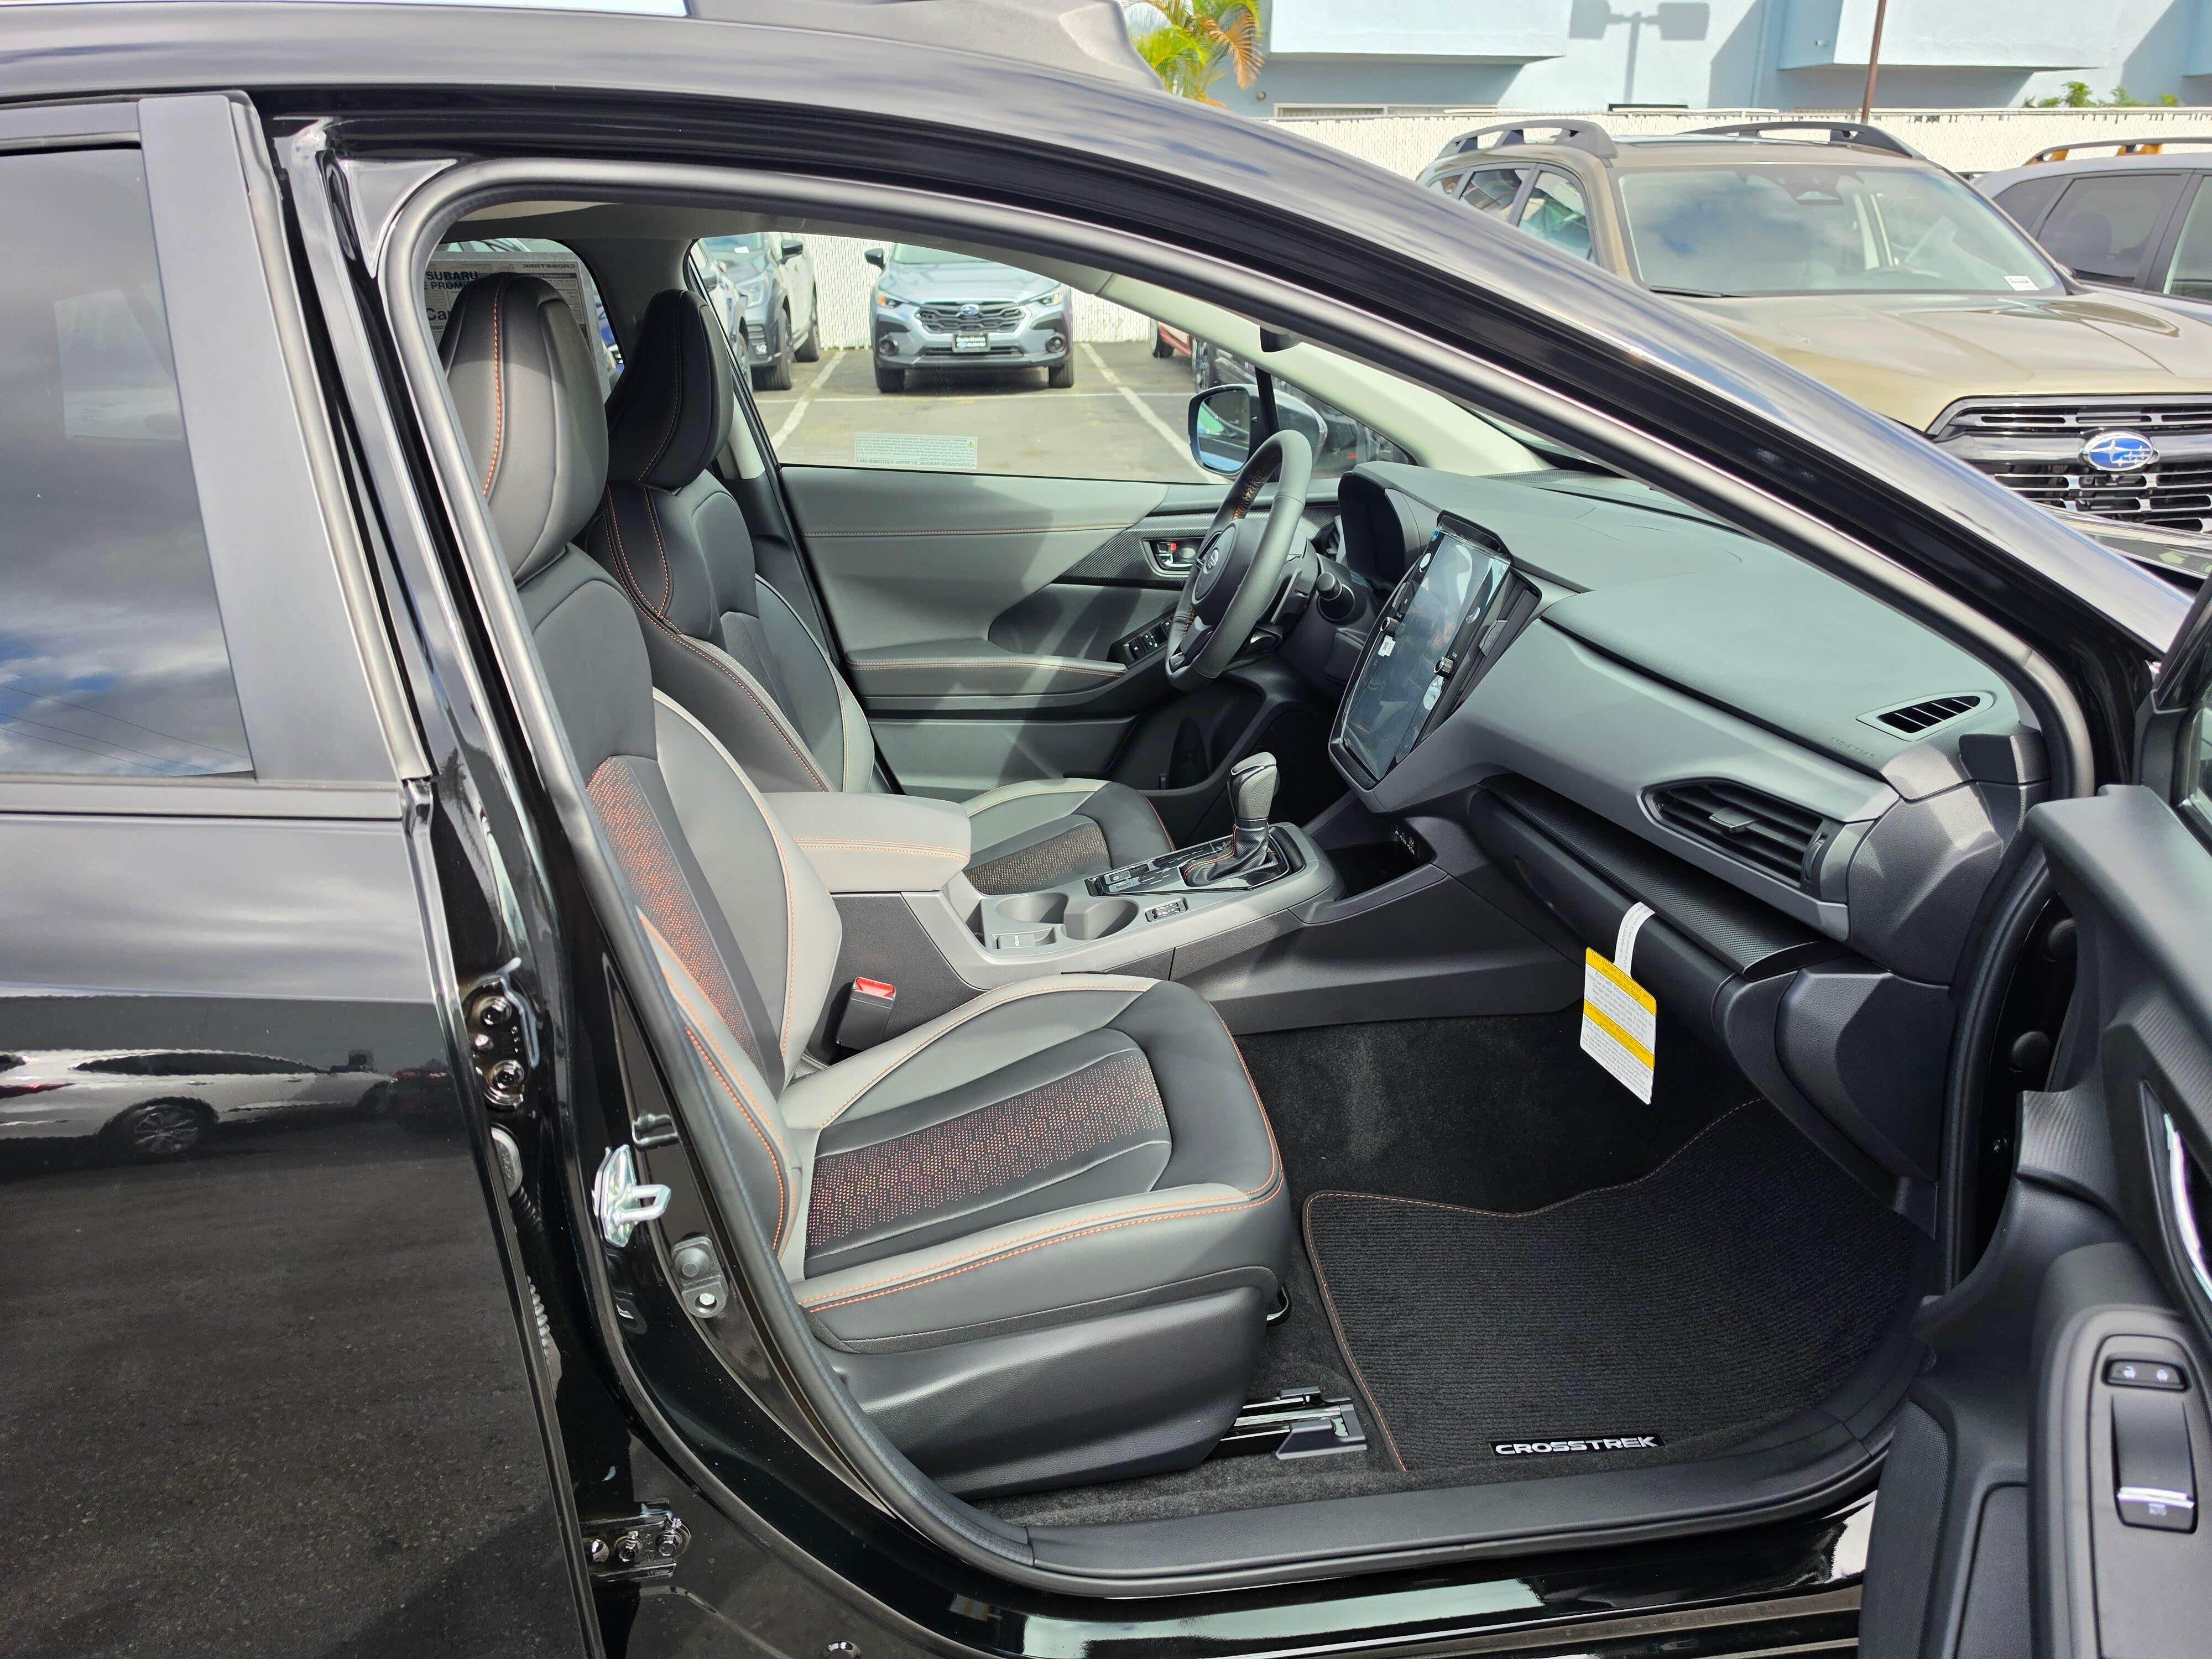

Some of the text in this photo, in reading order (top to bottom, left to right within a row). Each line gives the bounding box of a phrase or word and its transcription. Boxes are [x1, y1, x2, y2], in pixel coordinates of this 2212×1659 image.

[426, 271, 478, 280] SUBARU
[1591, 952, 1600, 962] This
[1602, 959, 1617, 975] Vehicle
[1624, 974, 1642, 994] Equipped
[1601, 967, 1622, 985] Advanced
[1630, 988, 1641, 1001] Bags
[1495, 1436, 1658, 1455] CROSSTREK
